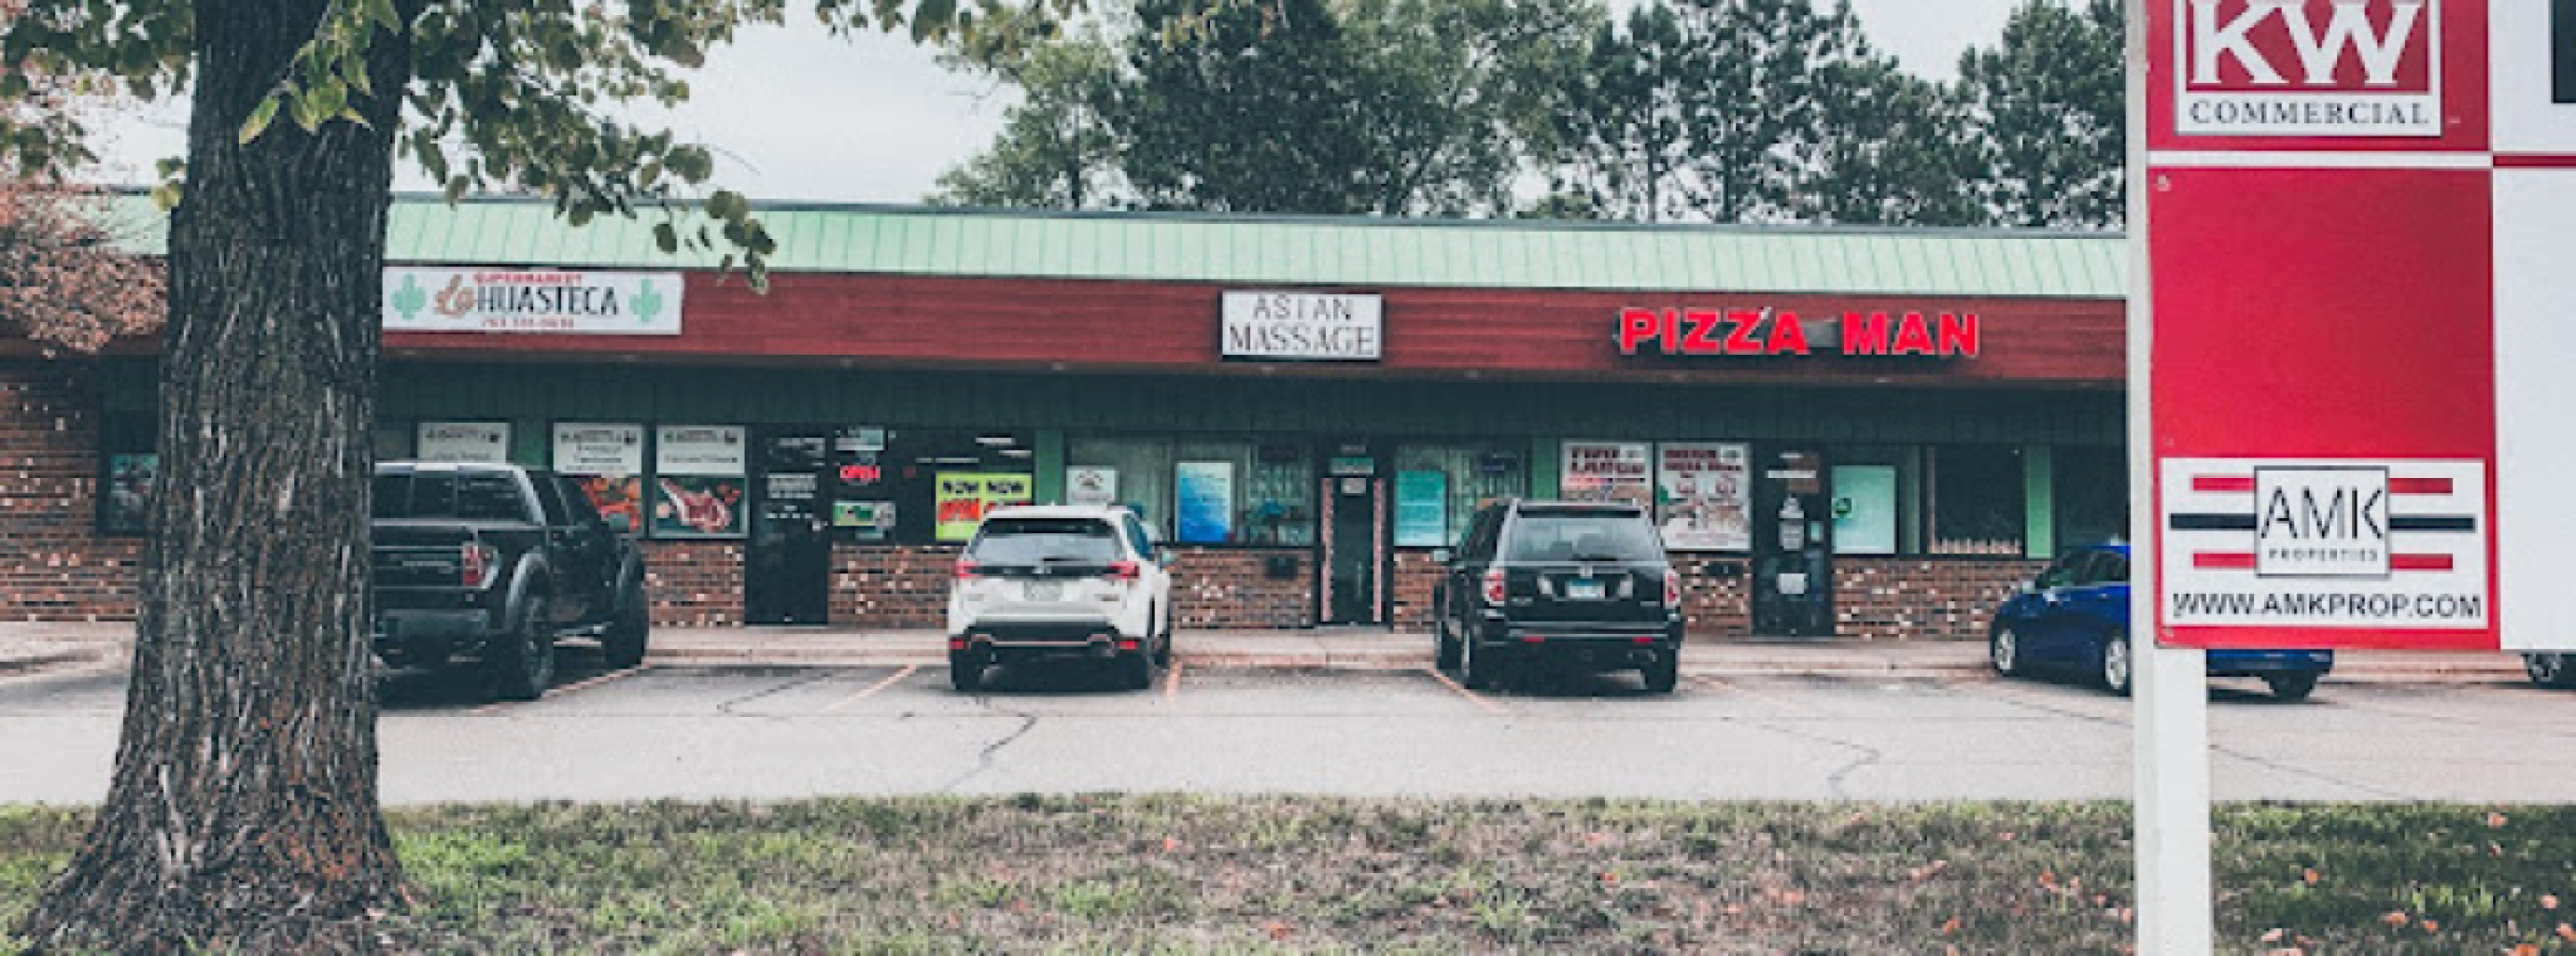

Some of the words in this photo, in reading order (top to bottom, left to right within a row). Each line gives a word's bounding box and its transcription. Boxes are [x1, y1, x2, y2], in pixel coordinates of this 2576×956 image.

[2189, 0, 2425, 87] KW
[2189, 100, 2431, 125] COMMERCIAL
[477, 286, 620, 316] HUASTECA
[1253, 294, 1354, 320] ASIAN
[1230, 322, 1375, 357] MASSAGE
[1619, 306, 1811, 357] PIZZA
[1841, 309, 1981, 358] MAN
[2260, 485, 2383, 540] AMK
[2268, 547, 2379, 561] PROPERTIES
[2173, 592, 2481, 618] WWW.AMKPROP.COM
